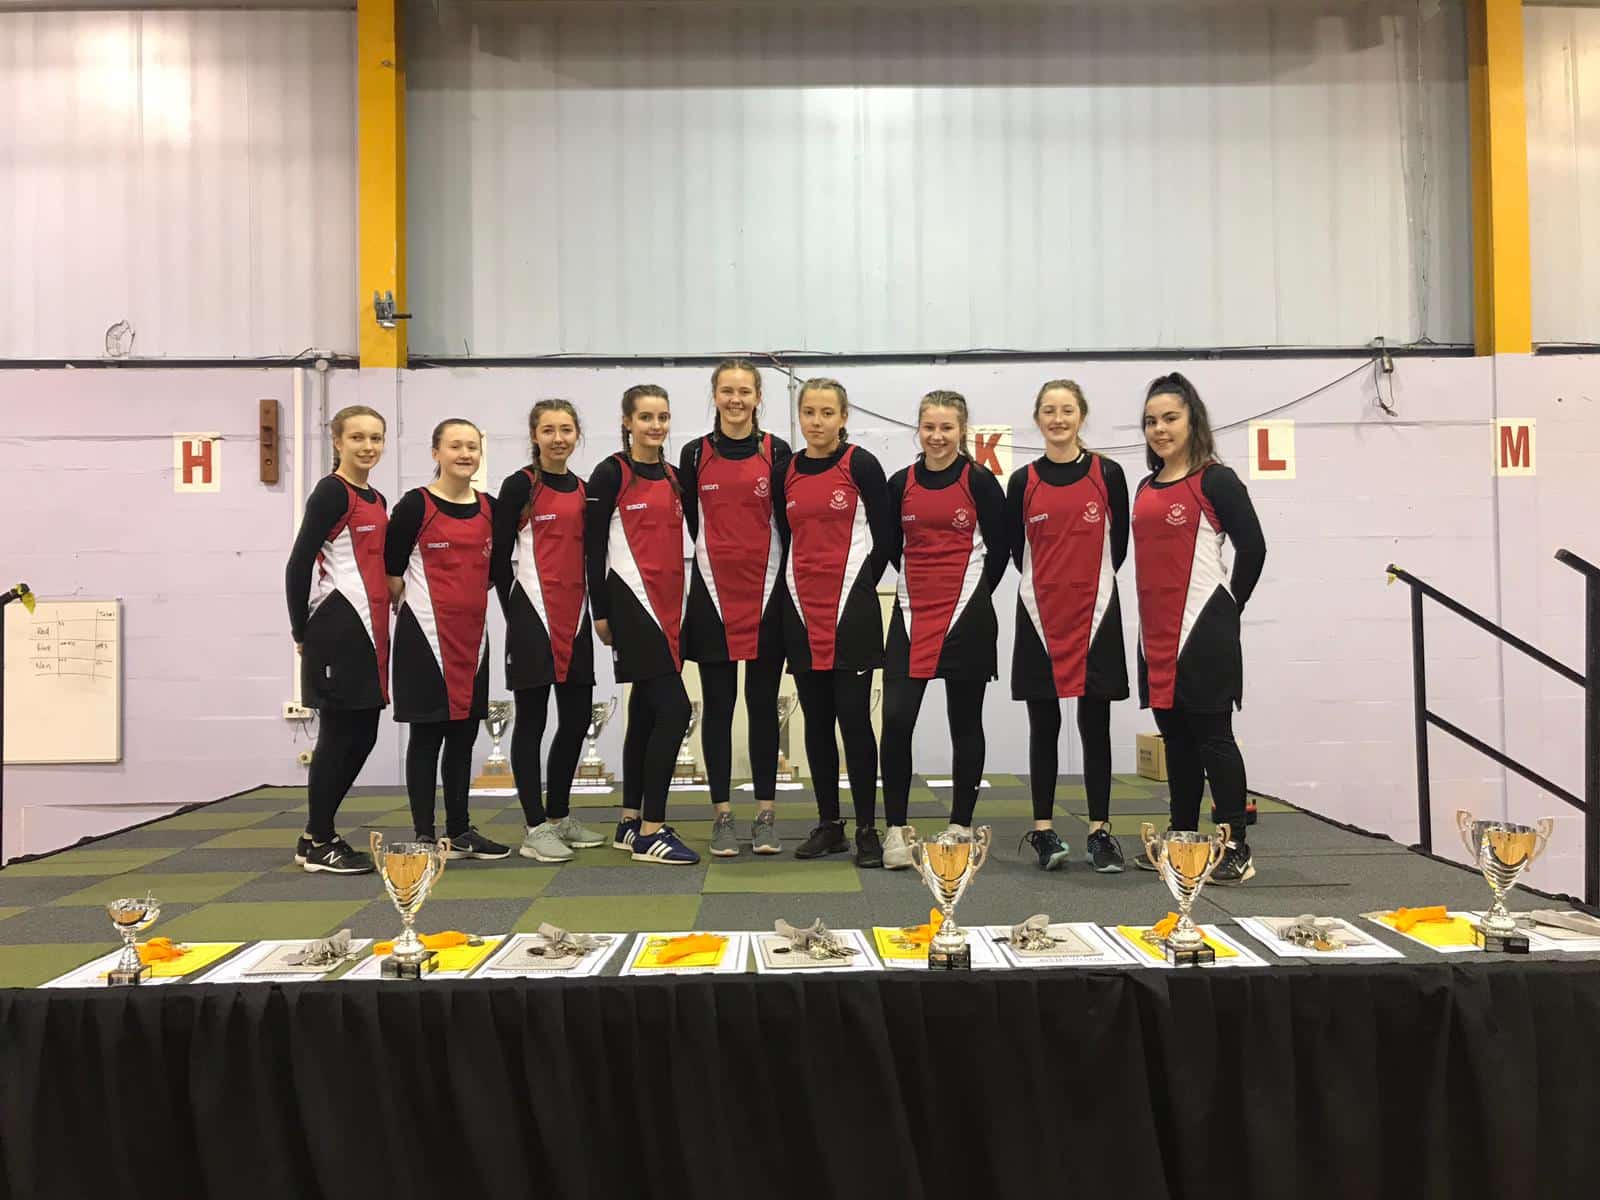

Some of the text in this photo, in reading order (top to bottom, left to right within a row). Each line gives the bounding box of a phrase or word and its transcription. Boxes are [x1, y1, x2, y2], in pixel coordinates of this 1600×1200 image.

[182, 440, 212, 484] H
[975, 433, 1003, 476] K
[1257, 428, 1287, 471] L
[1500, 425, 1530, 468] M
